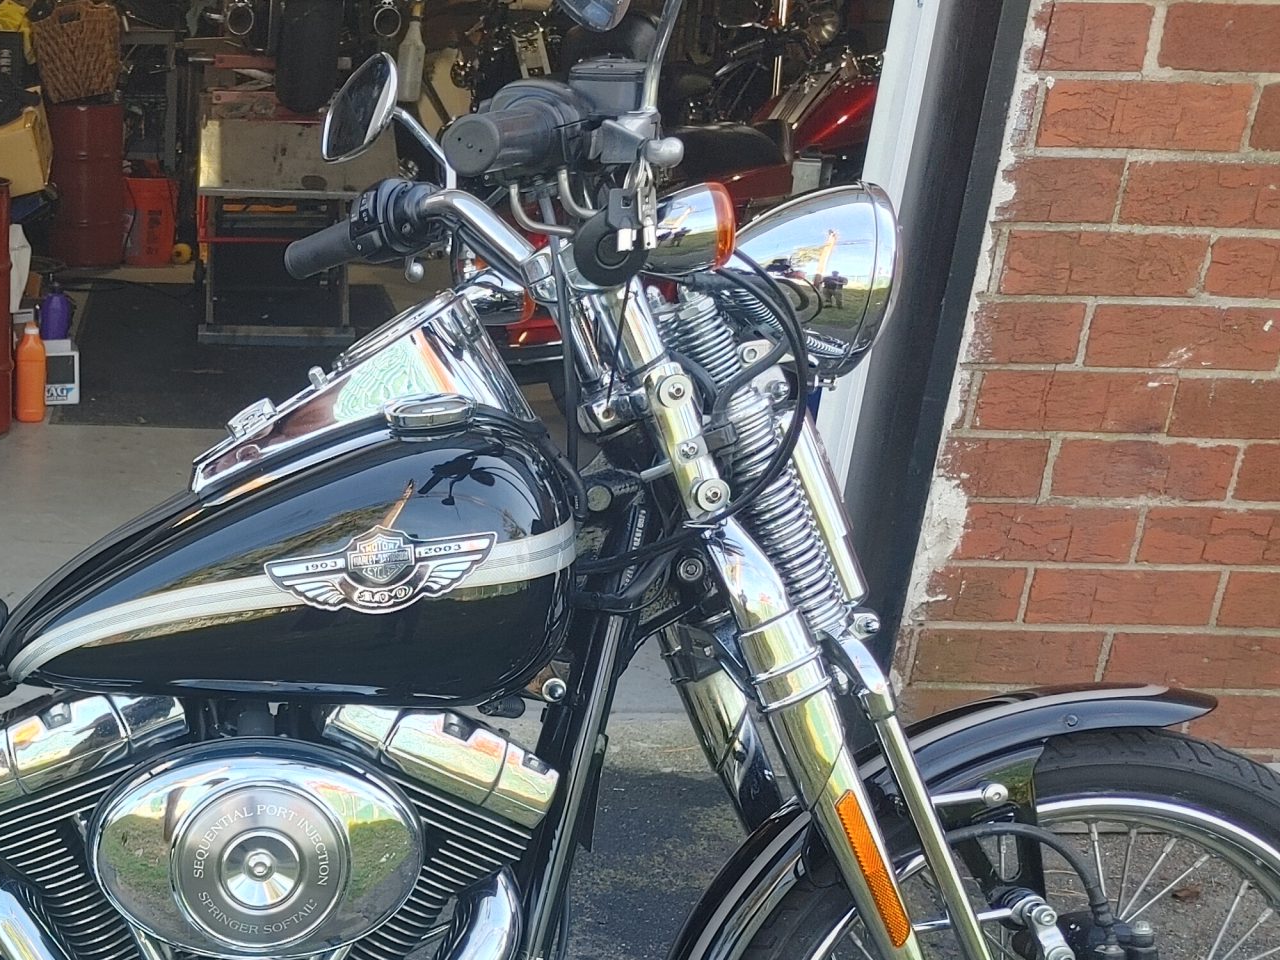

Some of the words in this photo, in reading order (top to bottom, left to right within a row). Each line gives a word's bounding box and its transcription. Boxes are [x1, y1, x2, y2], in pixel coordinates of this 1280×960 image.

[424, 543, 462, 555] 2003
[305, 560, 338, 572] 1903
[193, 807, 253, 879] SEQUENTIAL
[256, 804, 298, 821] PORT
[297, 817, 330, 886] INJECTION
[198, 891, 259, 935] SPRINGER
